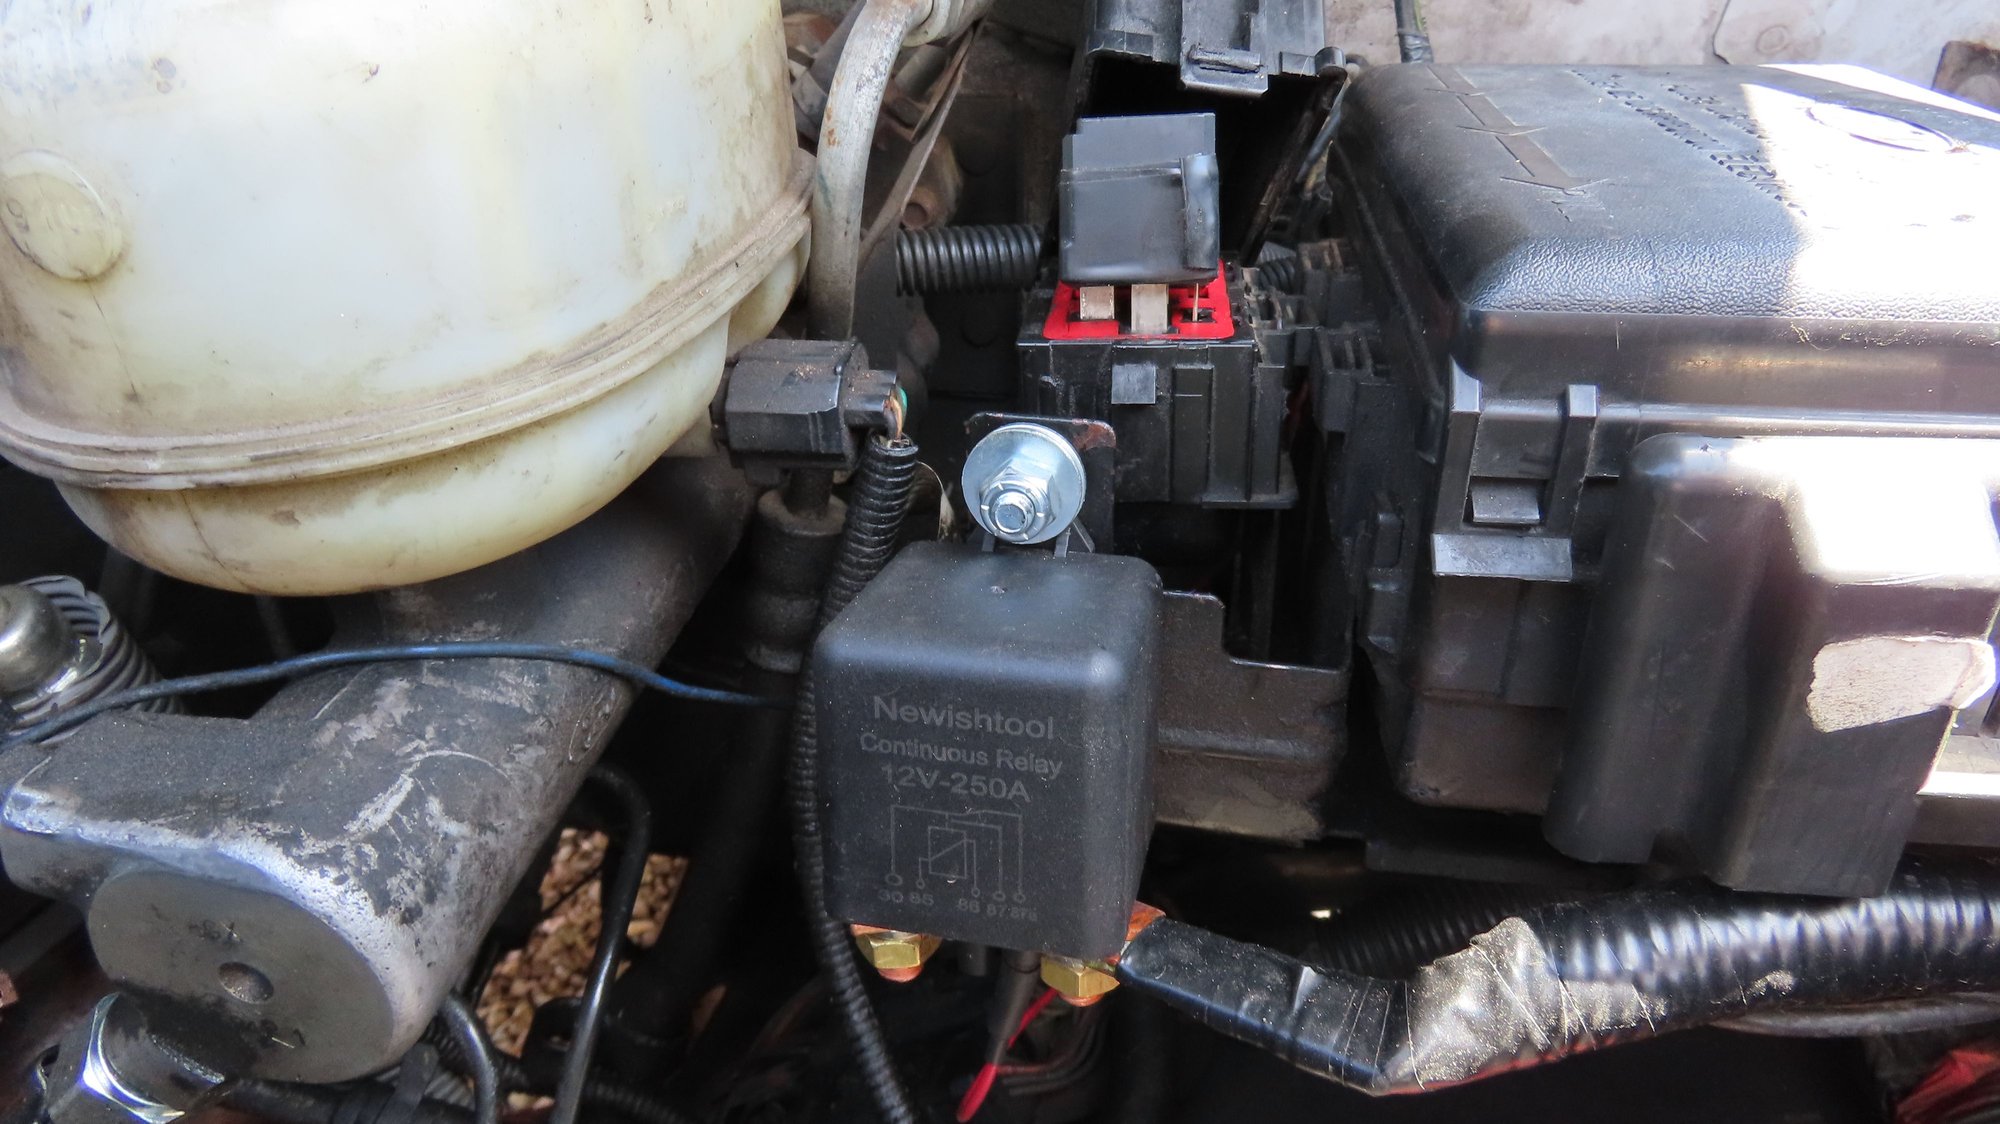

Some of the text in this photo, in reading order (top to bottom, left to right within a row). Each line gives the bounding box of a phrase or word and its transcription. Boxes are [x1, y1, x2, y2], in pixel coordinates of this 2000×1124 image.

[873, 696, 1055, 740] Newishtool
[860, 732, 1063, 780] Continuous Relay
[881, 762, 1031, 803] 12V-250A
